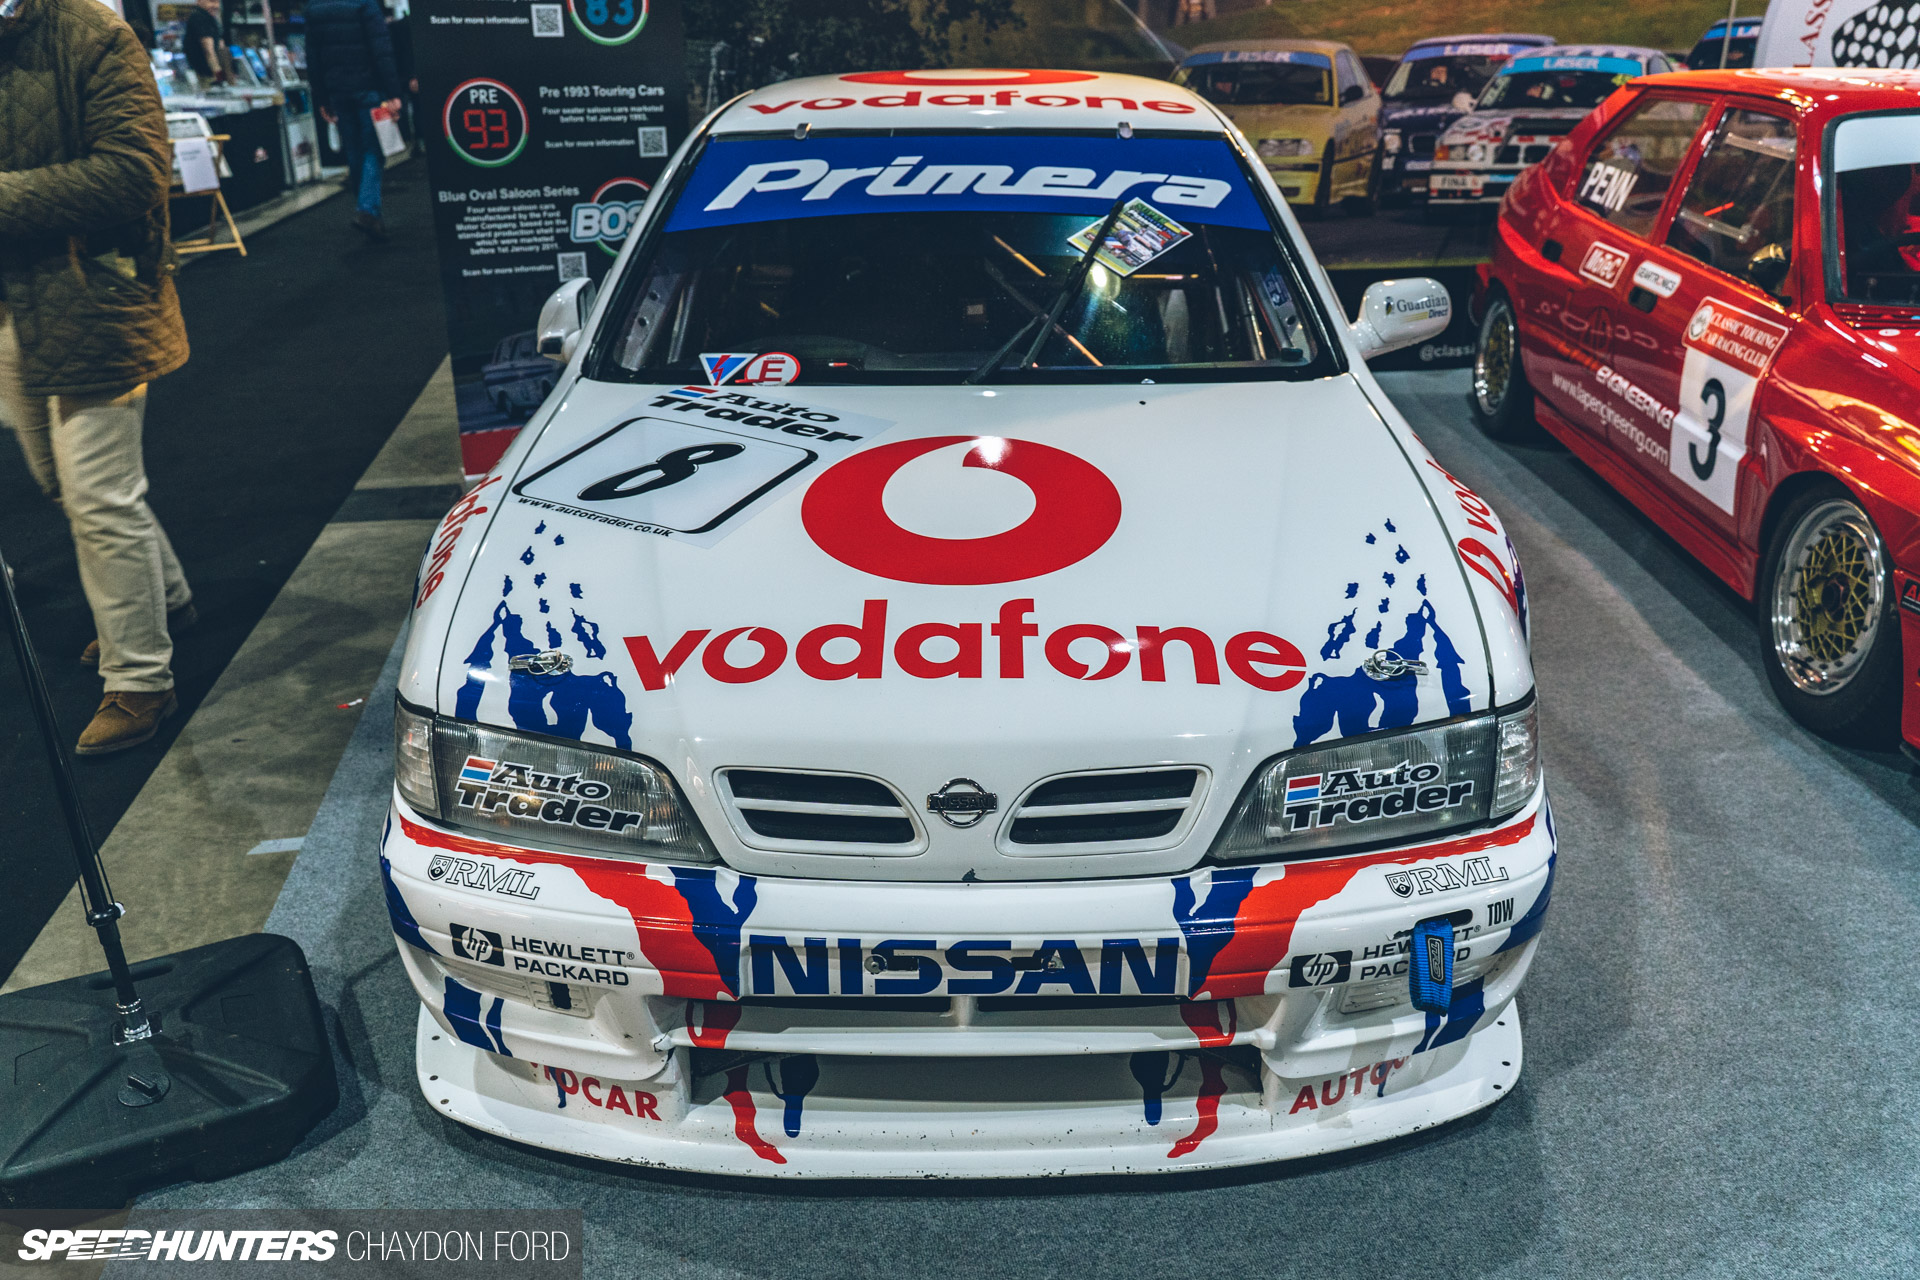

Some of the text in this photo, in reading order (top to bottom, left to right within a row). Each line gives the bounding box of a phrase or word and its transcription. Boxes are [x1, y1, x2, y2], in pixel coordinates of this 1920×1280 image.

[430, 15, 529, 24] Scan for more information
[469, 88, 498, 104] PRE
[539, 84, 665, 99] Pre 1993 Touring Cars
[749, 90, 1196, 114] vodafone
[463, 109, 510, 149] 93
[438, 185, 580, 202] Blue Oval Saloon Series
[703, 155, 1232, 211] Primera
[1580, 162, 1639, 212] PENN
[1397, 294, 1449, 313] Guardian
[1428, 308, 1449, 319] Direct
[1700, 329, 1768, 369] CAR RACING CLUB
[1711, 310, 1780, 351] CLASSIC TOURING
[649, 394, 864, 442] Trader
[702, 392, 840, 422] Auto
[1688, 378, 1726, 481] 3
[577, 442, 746, 501] 8
[518, 497, 674, 537] www.autotrader.co.uk
[622, 598, 1307, 692] vodafone
[490, 762, 612, 801] Auto
[1320, 760, 1441, 798] Auto
[455, 781, 644, 835] Trader
[1284, 776, 1475, 832] Trader
[446, 860, 541, 900] RML
[1414, 856, 1509, 896] RML
[1487, 898, 1514, 926] TOW
[514, 956, 629, 986] PACKARD
[749, 934, 1180, 995] NISSAN
